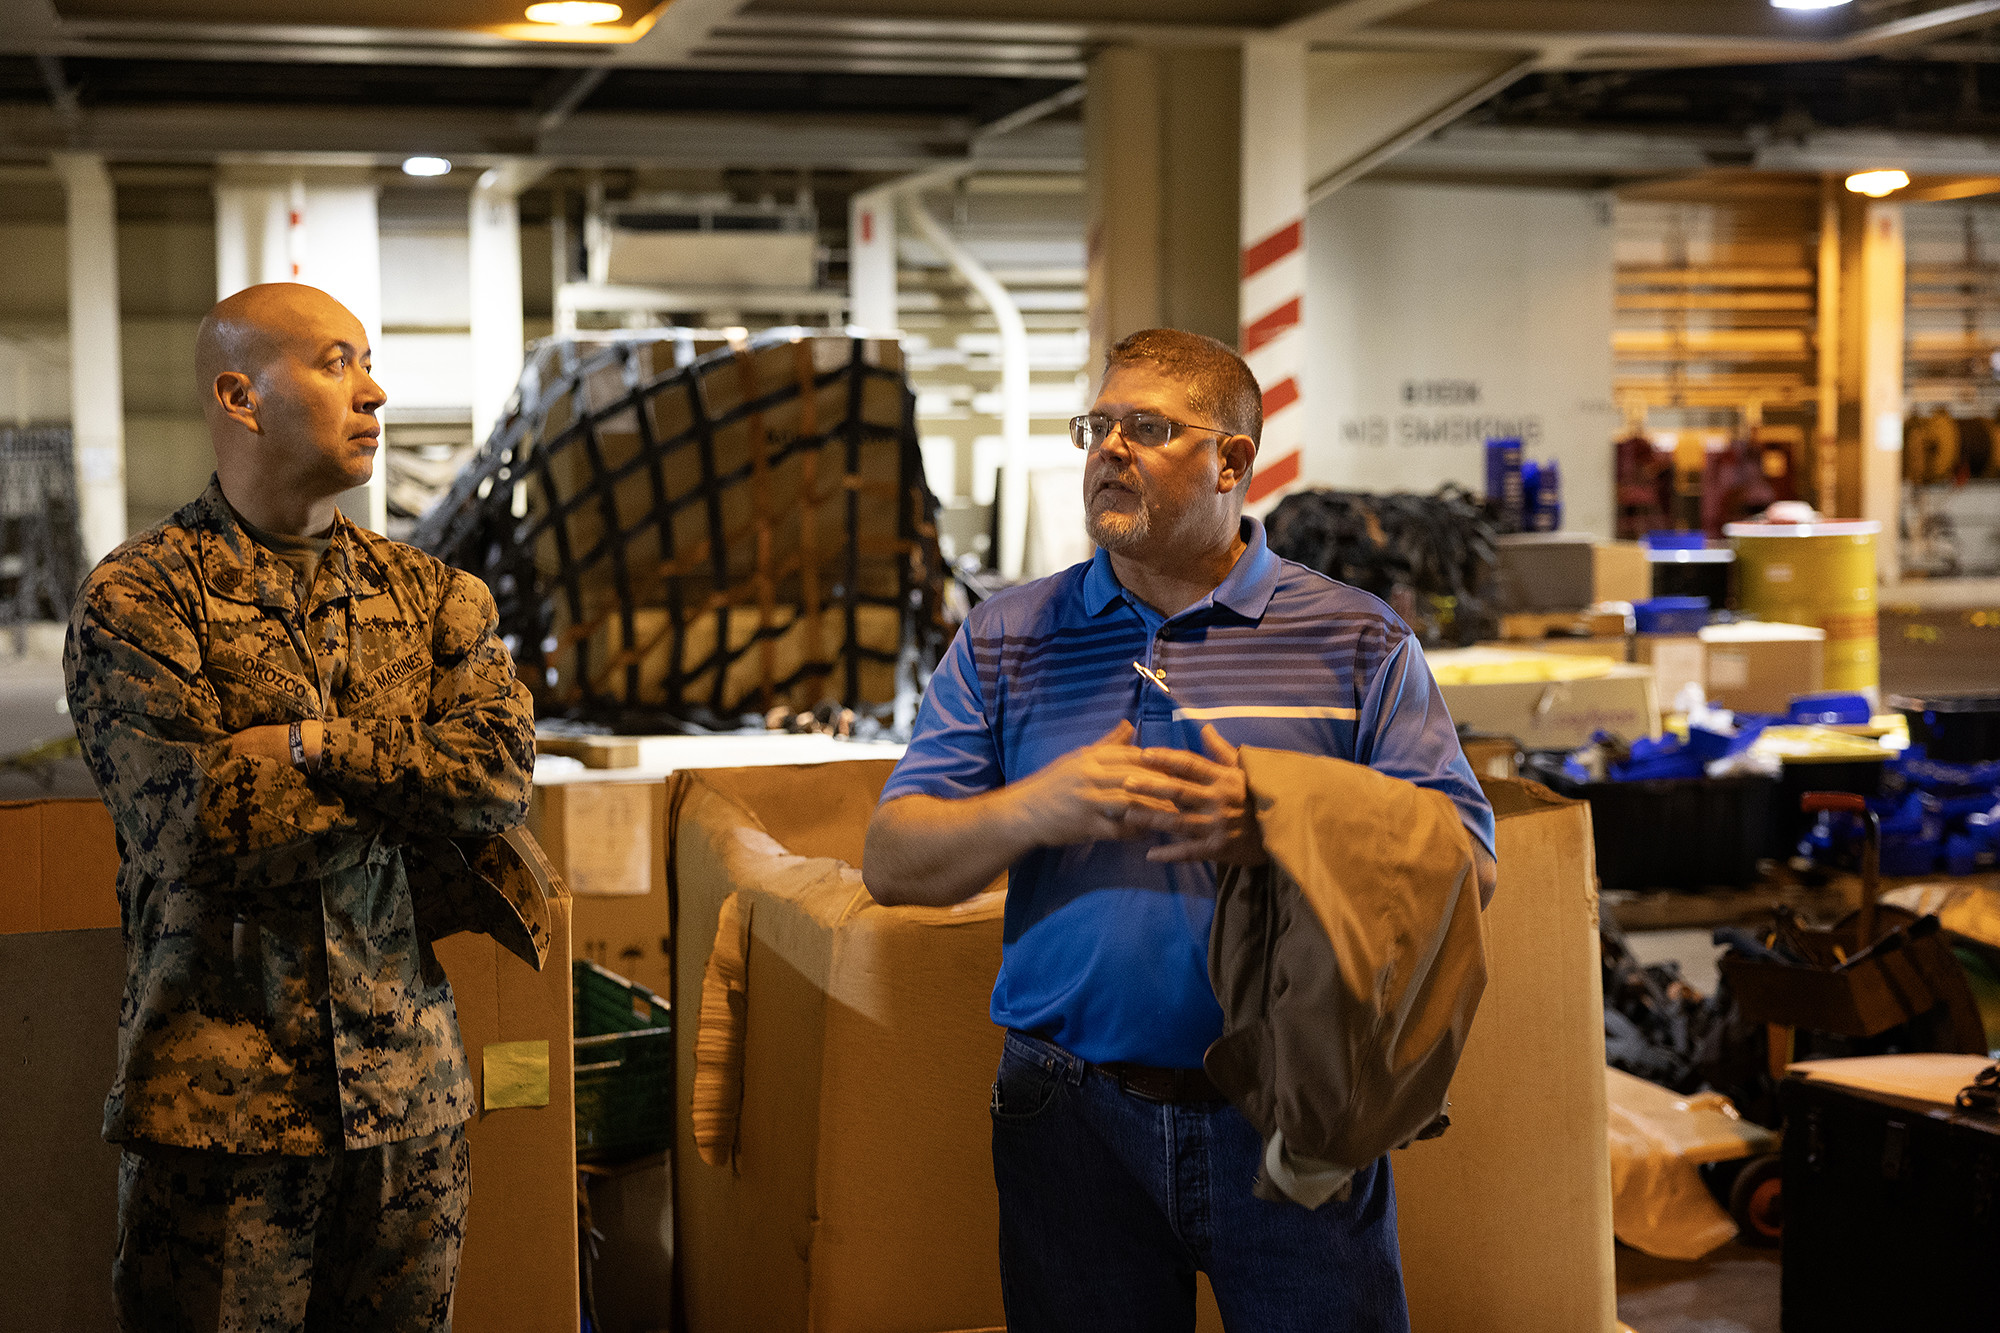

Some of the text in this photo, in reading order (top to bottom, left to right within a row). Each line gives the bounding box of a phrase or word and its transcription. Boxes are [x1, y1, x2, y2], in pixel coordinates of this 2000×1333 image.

[1342, 415, 1541, 445] NO SMOKING
[242, 658, 306, 698] OROZCO
[373, 651, 424, 690] MARINES
